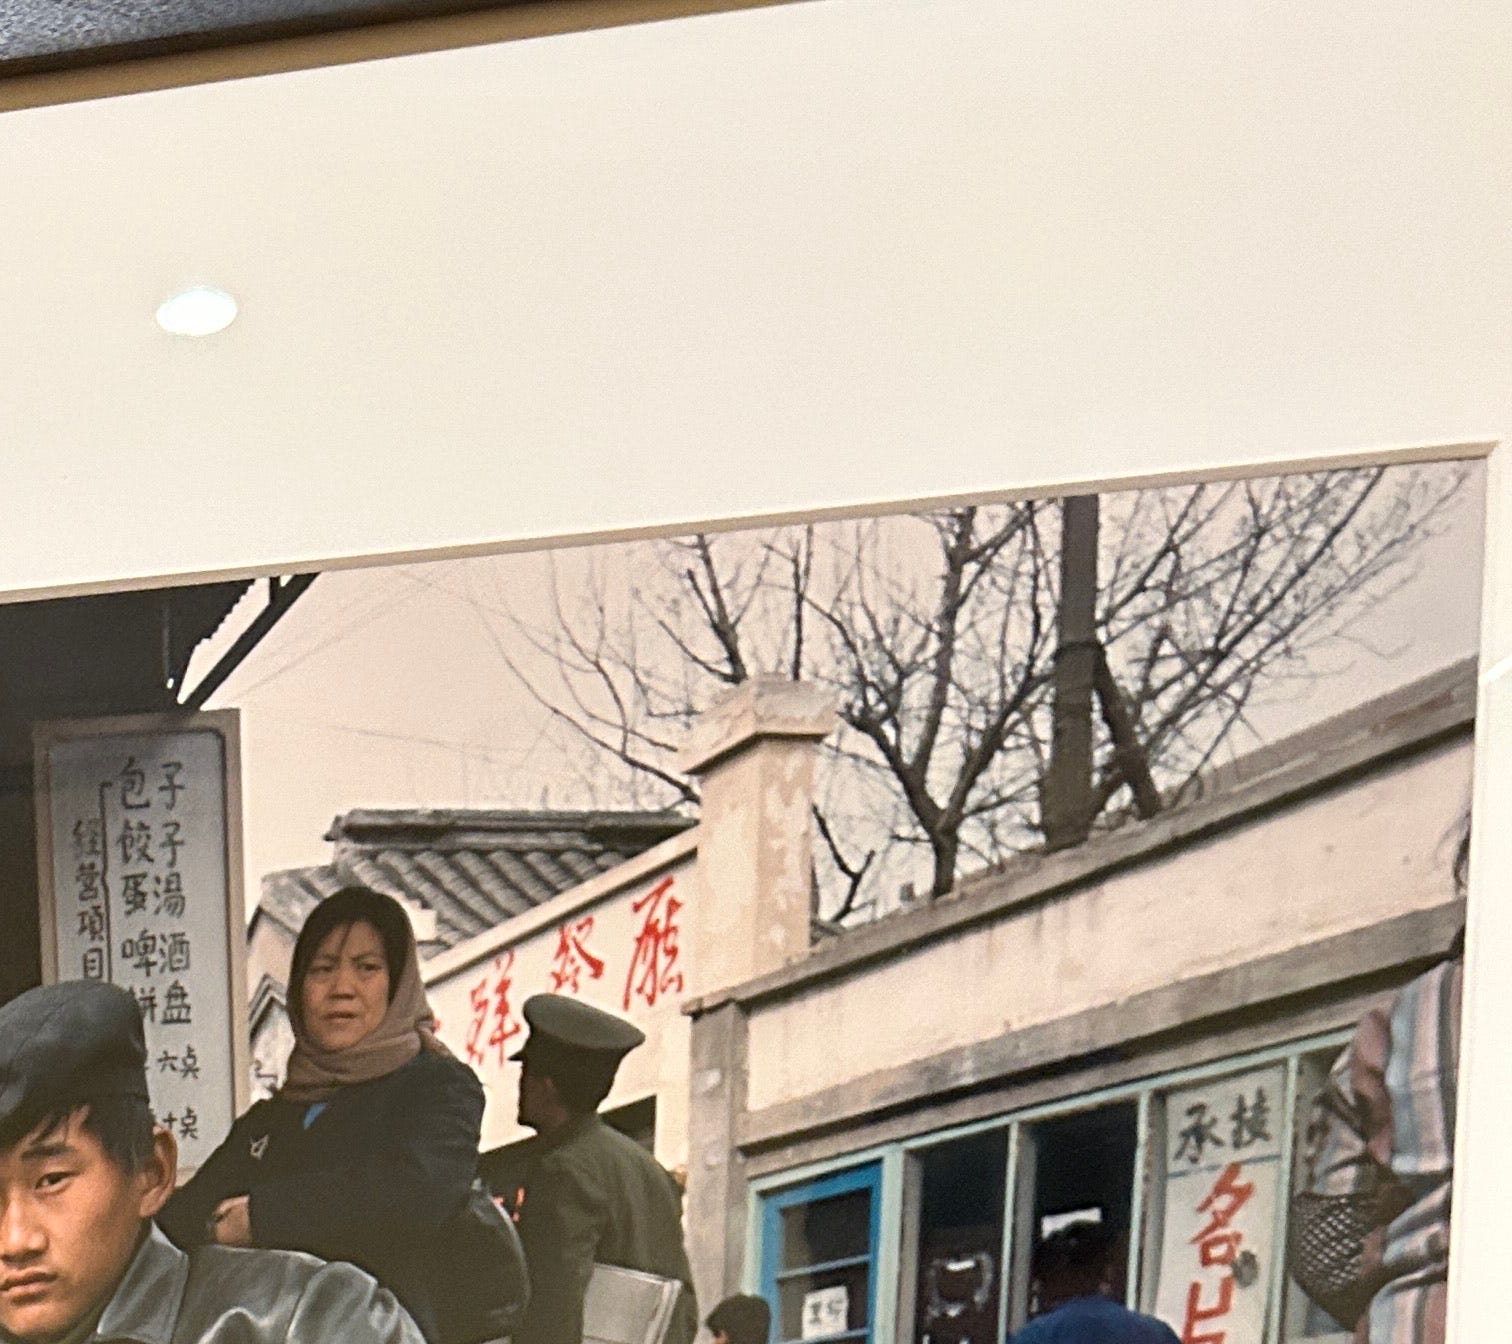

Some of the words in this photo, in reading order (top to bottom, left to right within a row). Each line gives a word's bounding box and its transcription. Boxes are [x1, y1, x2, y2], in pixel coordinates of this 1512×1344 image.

[118, 756, 186, 811] 包子
[120, 871, 187, 920] 蛋湯
[121, 929, 192, 978] 啤酒
